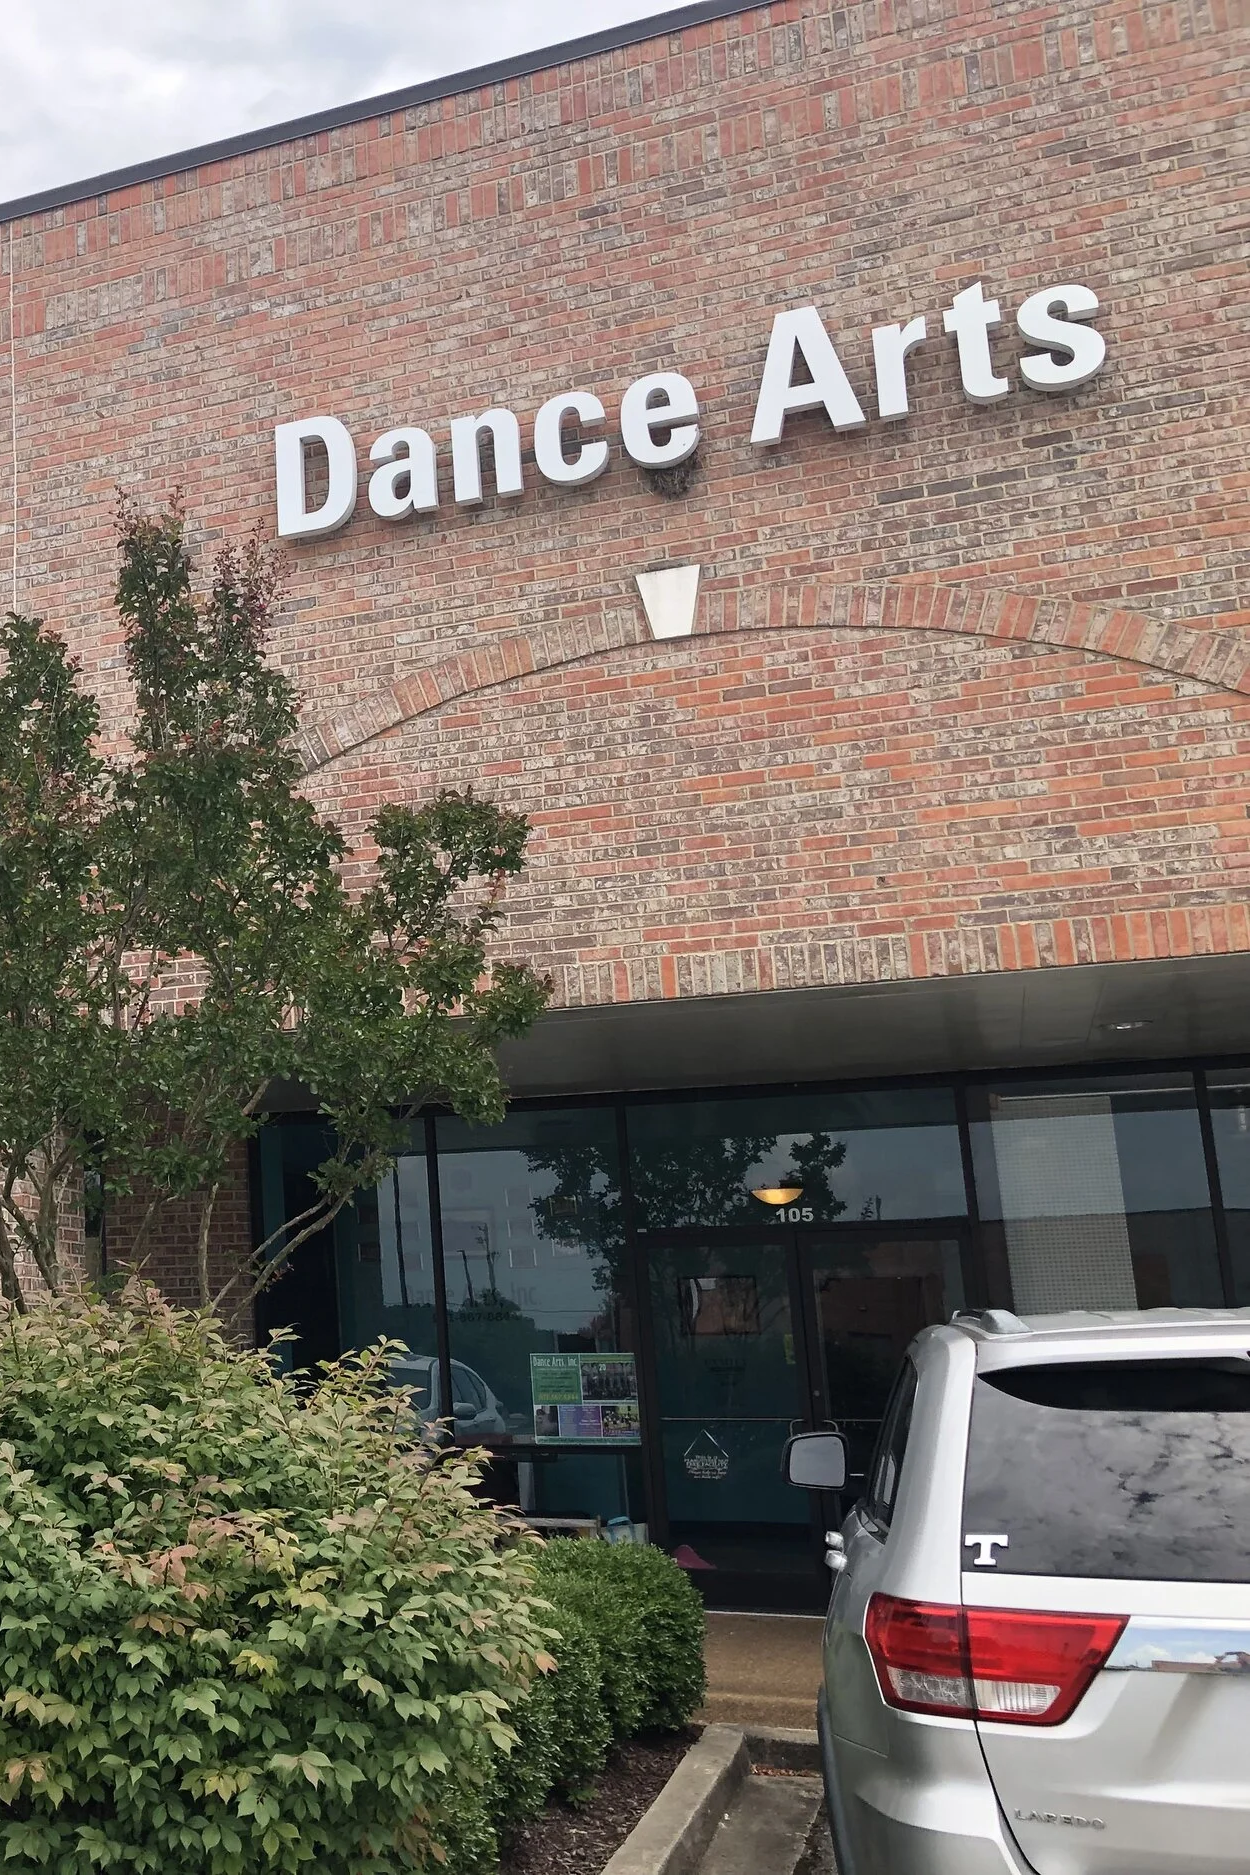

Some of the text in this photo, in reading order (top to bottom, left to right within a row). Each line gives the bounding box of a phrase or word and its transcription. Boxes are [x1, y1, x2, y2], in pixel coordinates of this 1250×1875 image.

[275, 280, 1107, 540] Dance Arts
[775, 1207, 814, 1223] 105
[532, 1356, 550, 1367] Dance
[964, 1534, 1009, 1567] T
[1014, 1807, 1107, 1830] LAREDO
